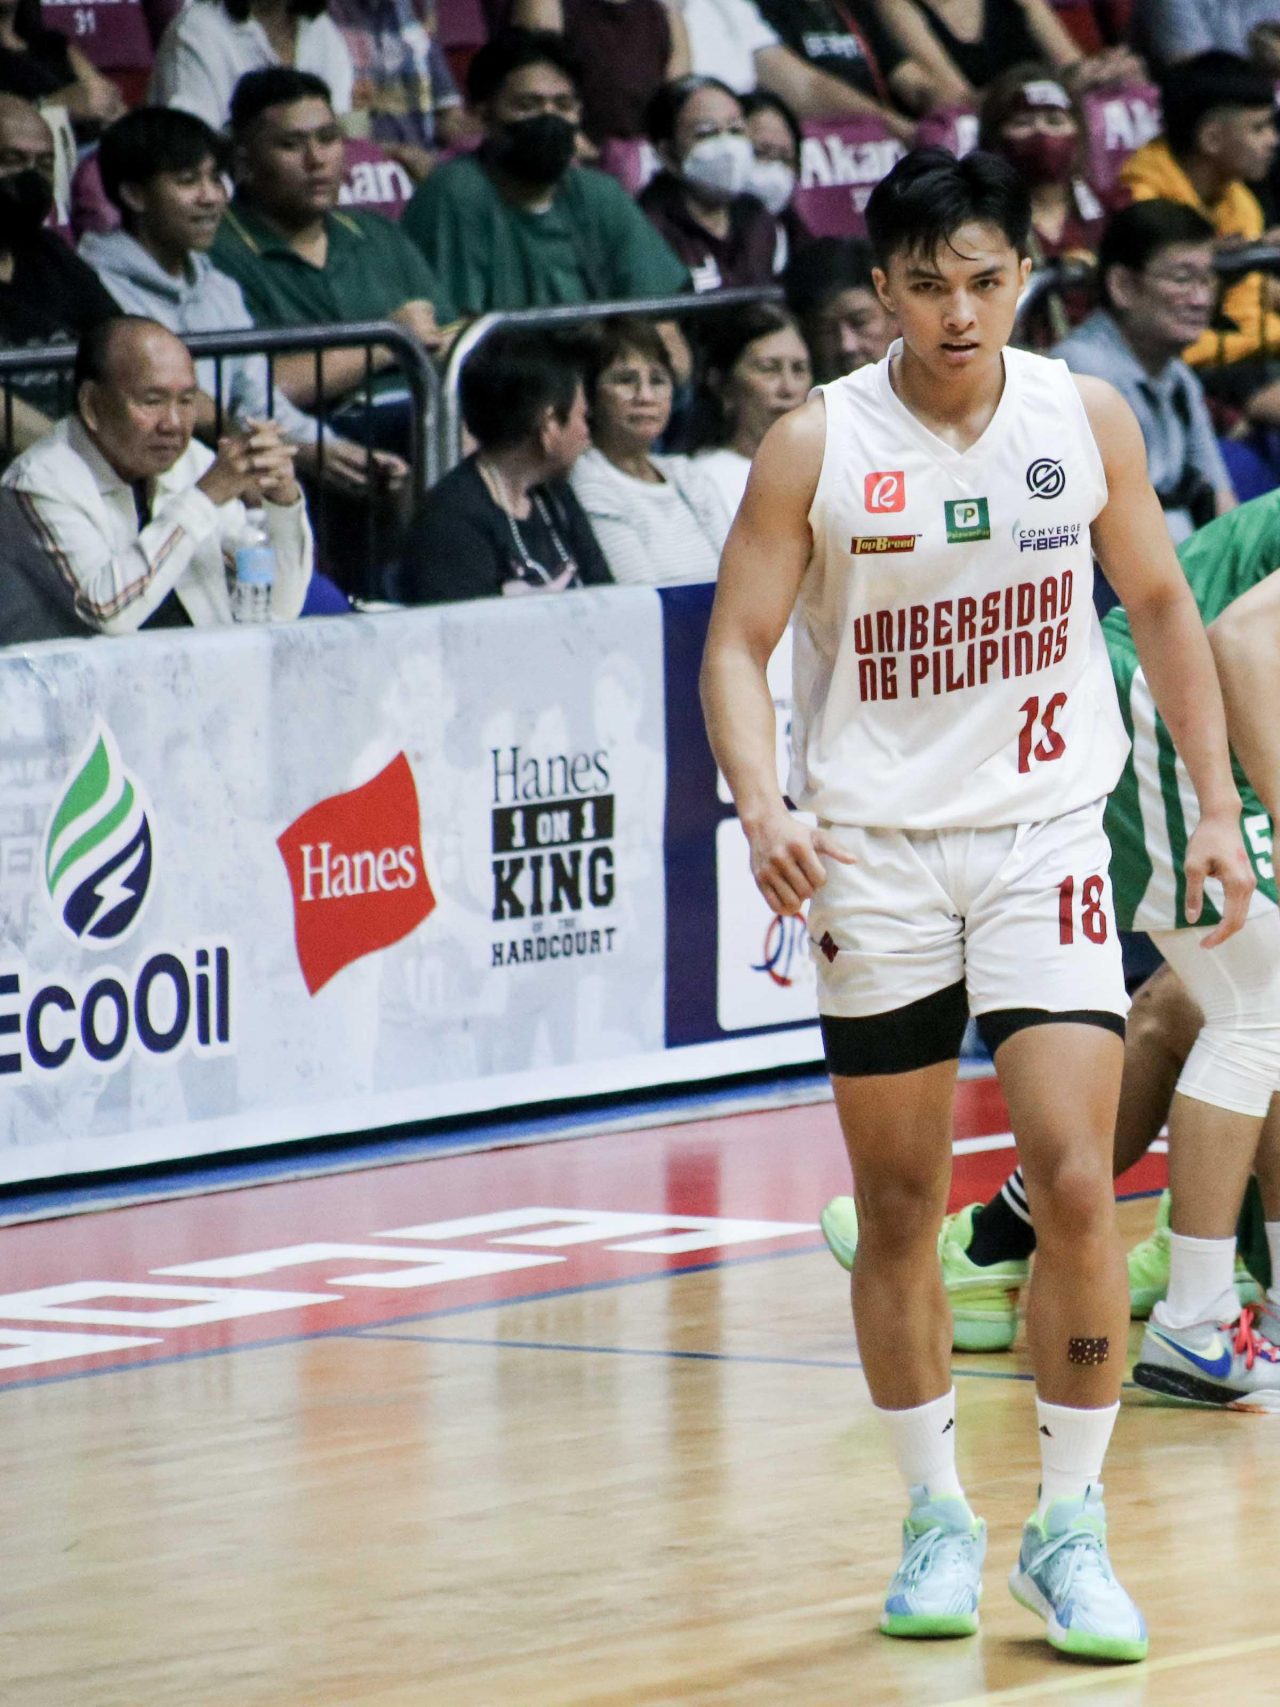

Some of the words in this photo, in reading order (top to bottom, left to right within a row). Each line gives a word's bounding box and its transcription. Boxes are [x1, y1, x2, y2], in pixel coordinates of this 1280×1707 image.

[1020, 524, 1081, 539] CONVERGE
[853, 569, 1073, 655] UNIBERSIDAD
[858, 656, 898, 702] NG
[910, 617, 1069, 698] PILIPINAS
[492, 747, 611, 803] Hanes
[511, 808, 526, 848] 1
[537, 809, 572, 845] ON
[581, 800, 596, 839] 1
[300, 842, 416, 902] Hanes
[492, 846, 616, 922] KING
[1055, 874, 1107, 945] 18
[492, 927, 617, 967] HARDCOURT
